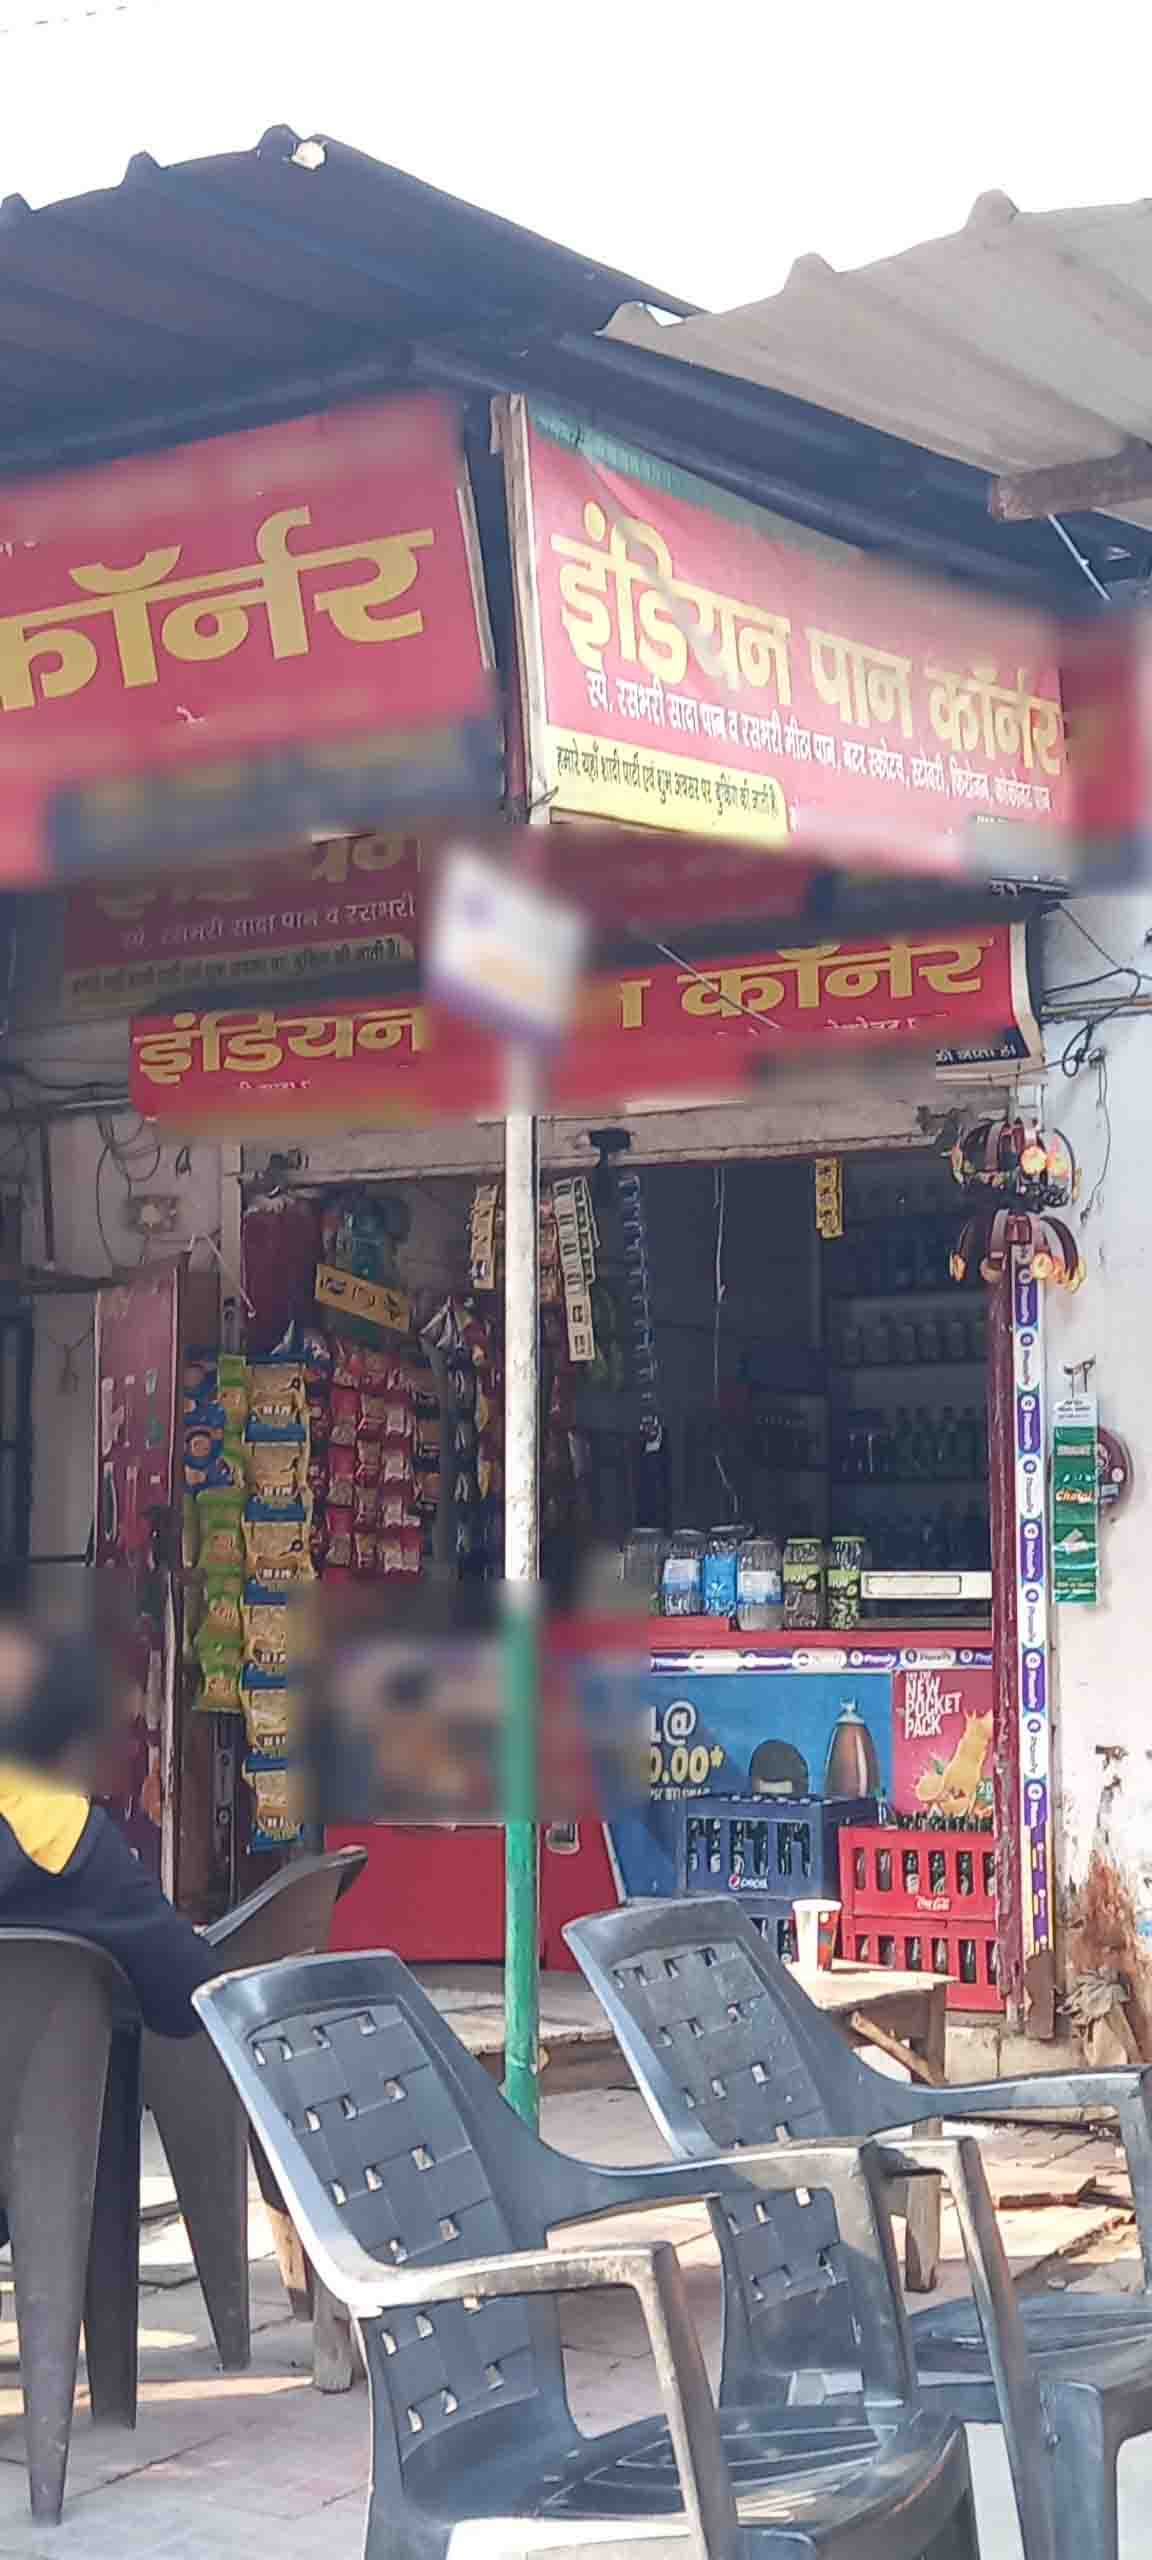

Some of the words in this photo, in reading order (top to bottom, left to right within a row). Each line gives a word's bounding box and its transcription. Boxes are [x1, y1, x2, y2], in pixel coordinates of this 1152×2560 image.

[803, 626, 912, 738] पान
[133, 1009, 426, 1084] इंडियन
[905, 1676, 941, 1699] NEW
[905, 1692, 962, 1717] POCKET
[905, 1714, 942, 1739] PACK
